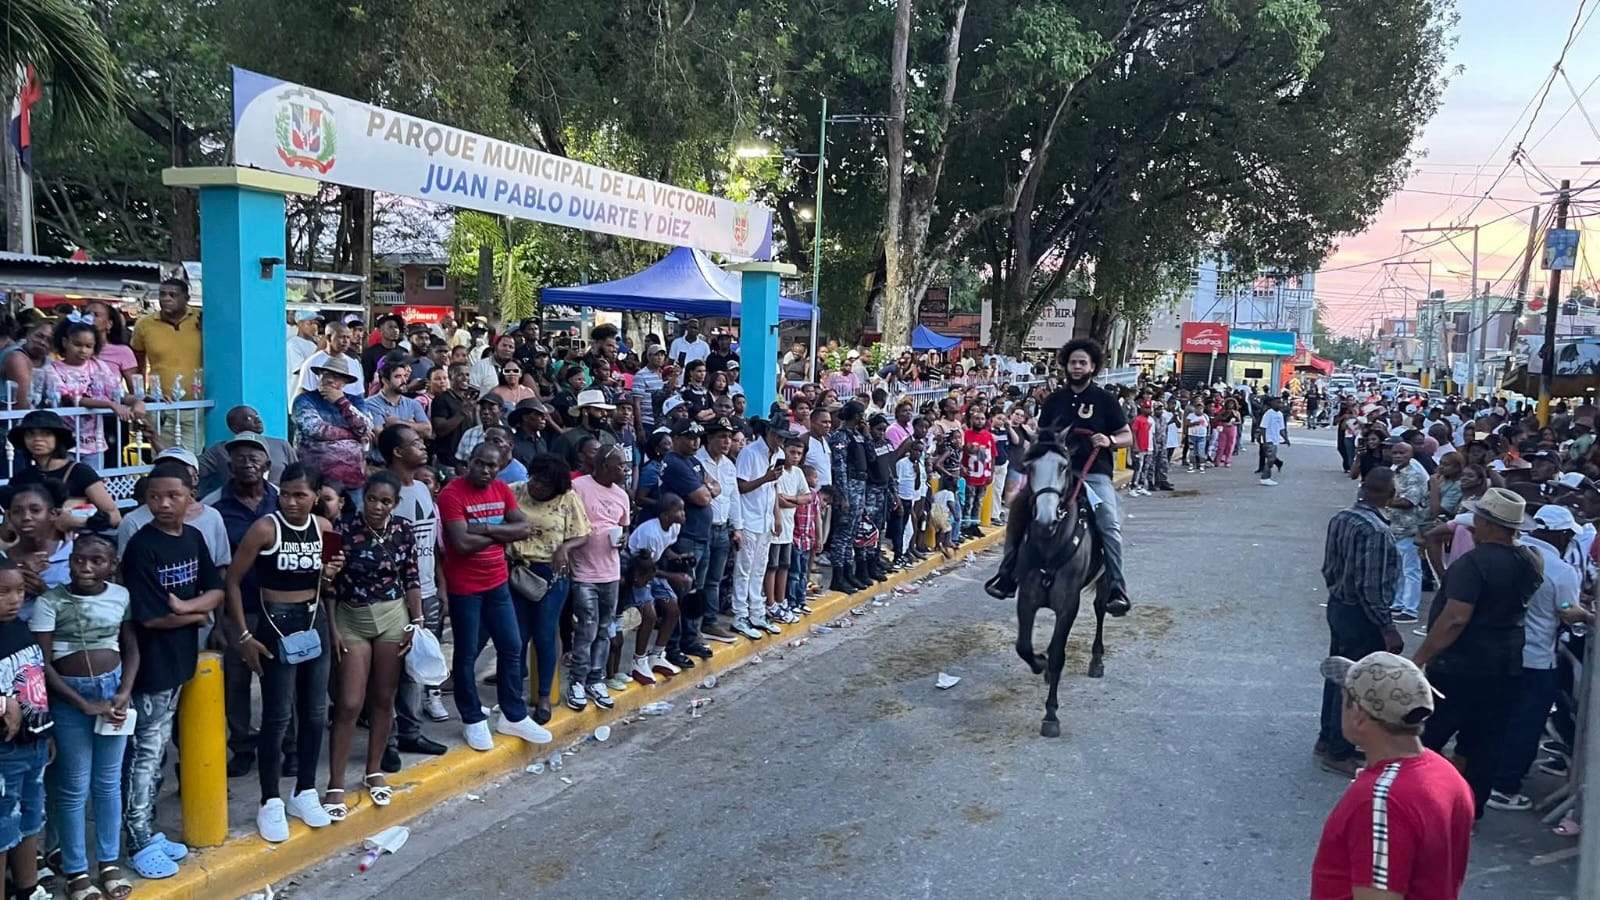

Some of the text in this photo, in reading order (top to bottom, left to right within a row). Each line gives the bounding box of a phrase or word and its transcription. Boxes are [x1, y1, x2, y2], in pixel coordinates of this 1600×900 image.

[366, 111, 717, 219] PARQUE MUNICIPAL DE LA VICTORIA
[420, 162, 691, 240] JUAN PABLO DUARTE Y DÍEZ
[279, 541, 300, 553] LONG
